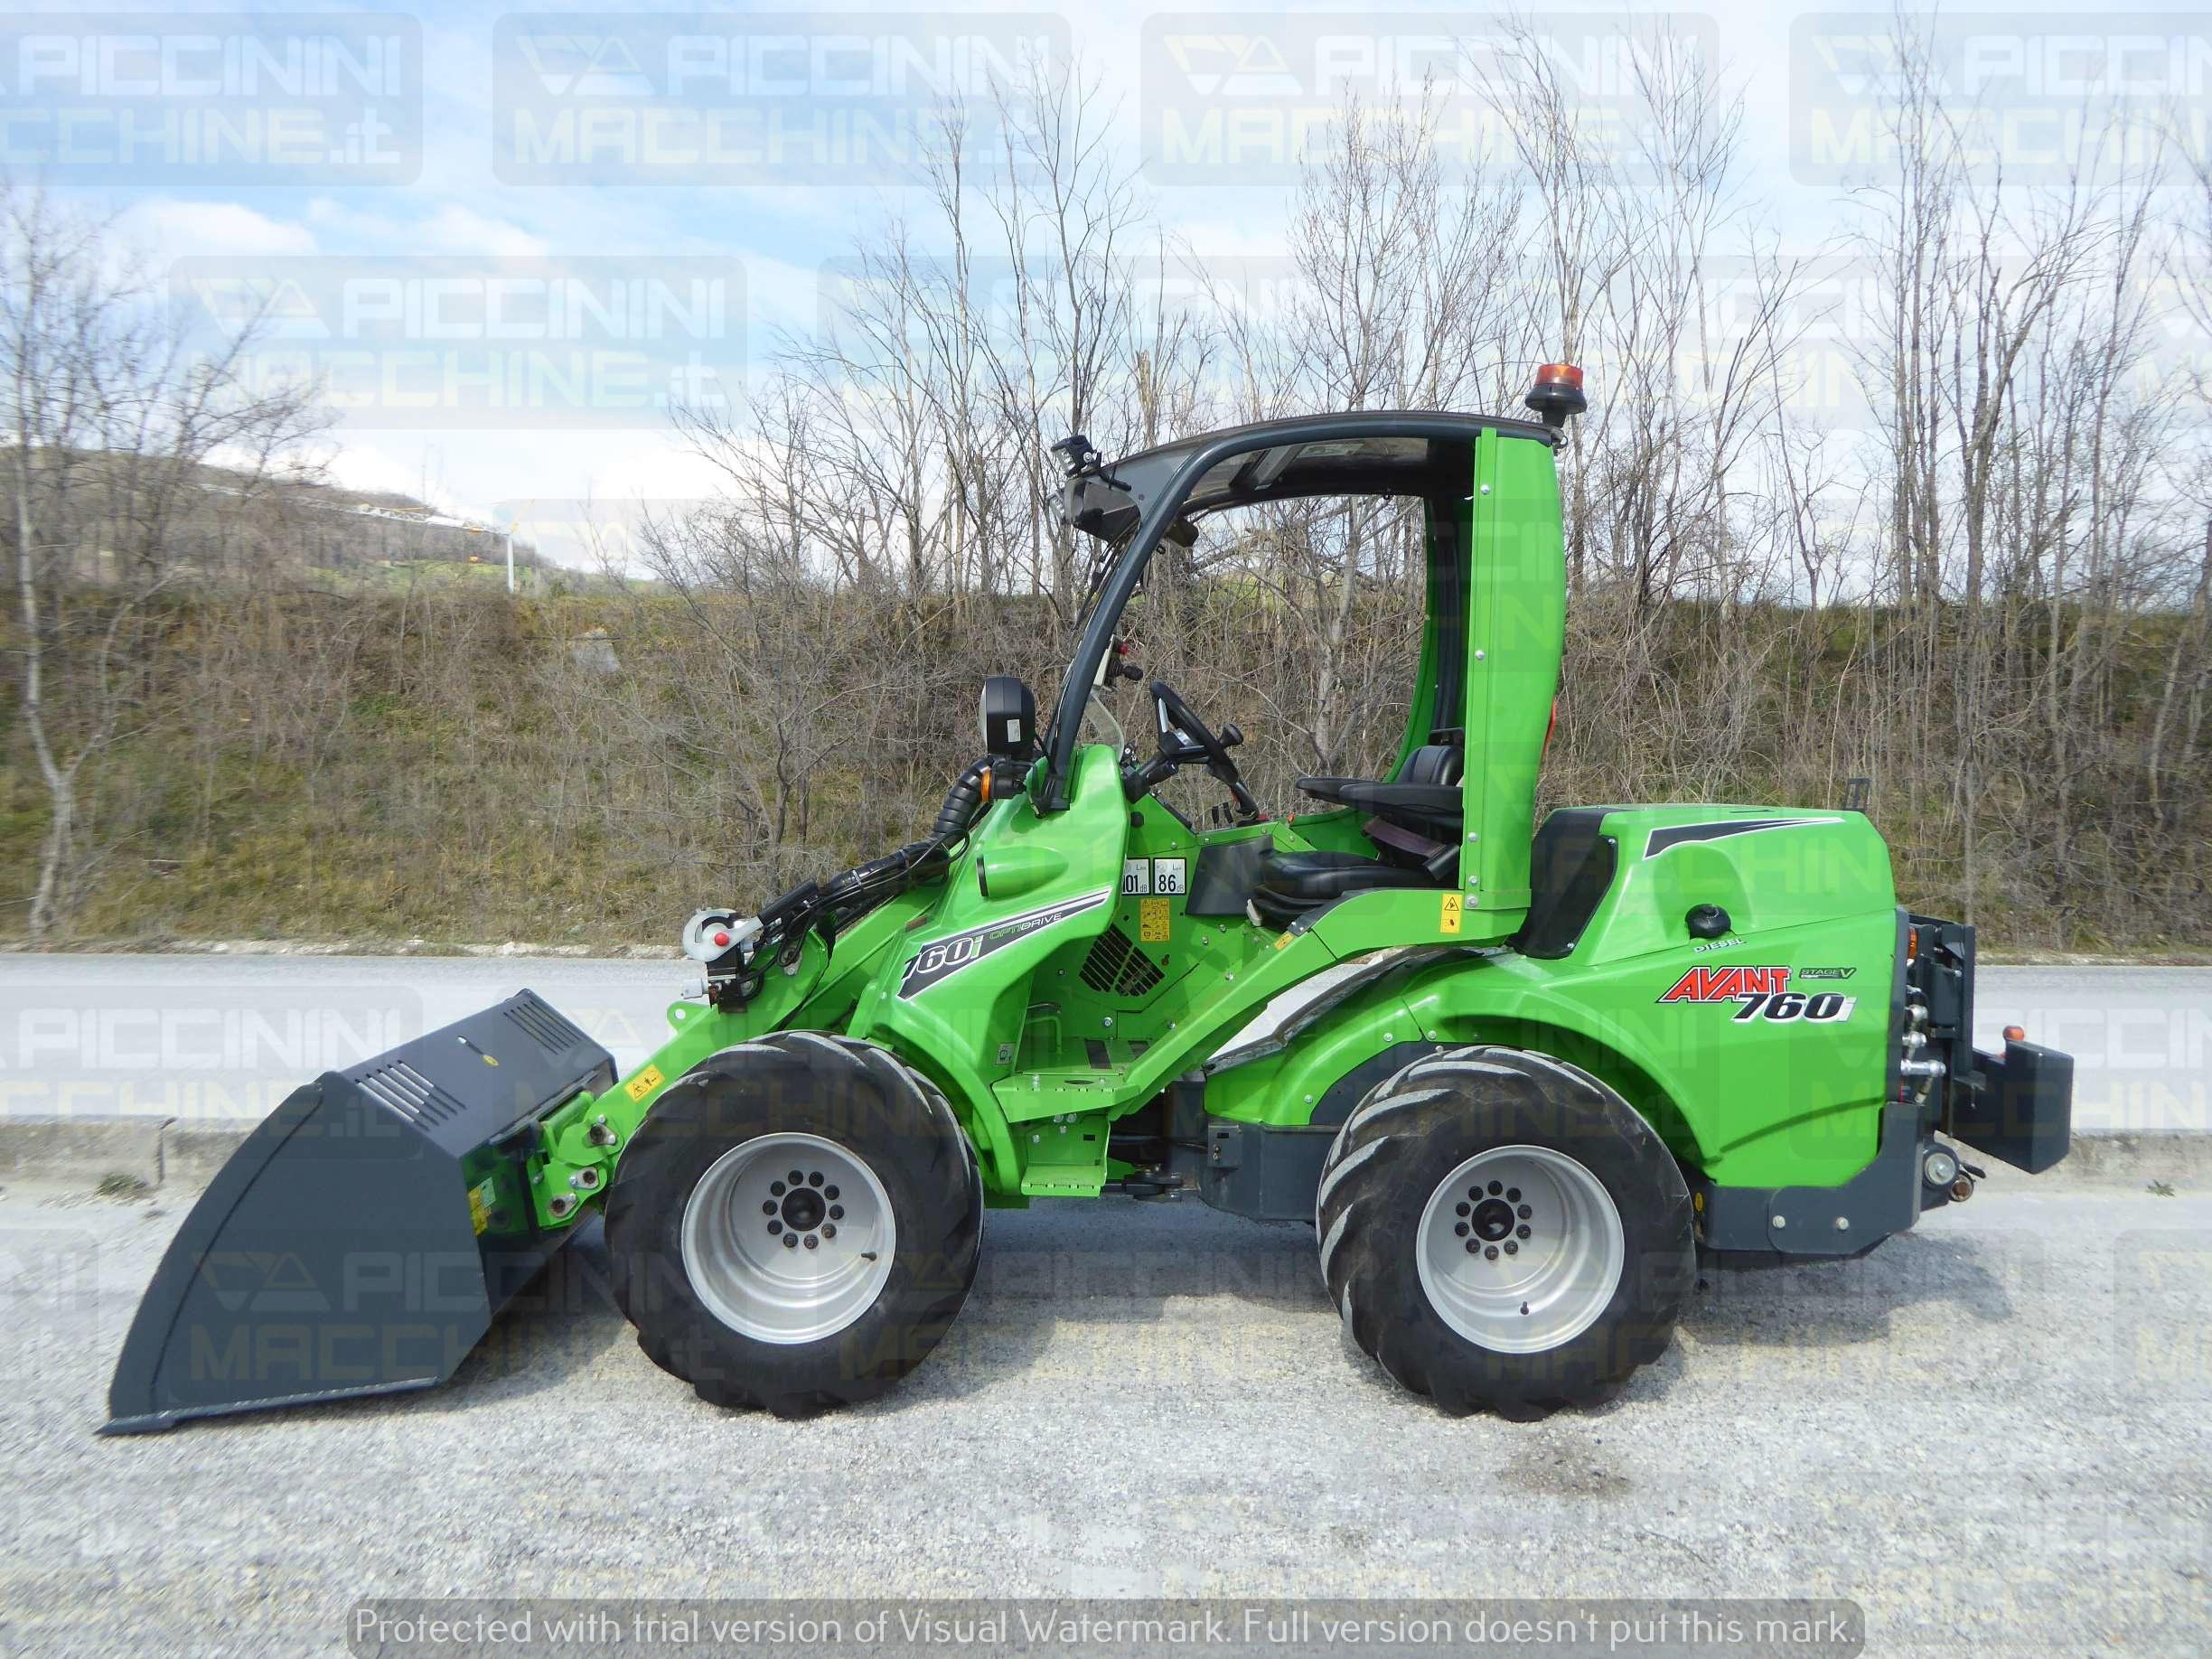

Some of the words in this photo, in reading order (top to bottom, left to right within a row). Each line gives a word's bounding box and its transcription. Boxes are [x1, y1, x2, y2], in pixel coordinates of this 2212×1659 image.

[1158, 874, 1176, 893] 86
[1693, 938, 1746, 953] DIESEL
[1659, 966, 1791, 1003] AVANT
